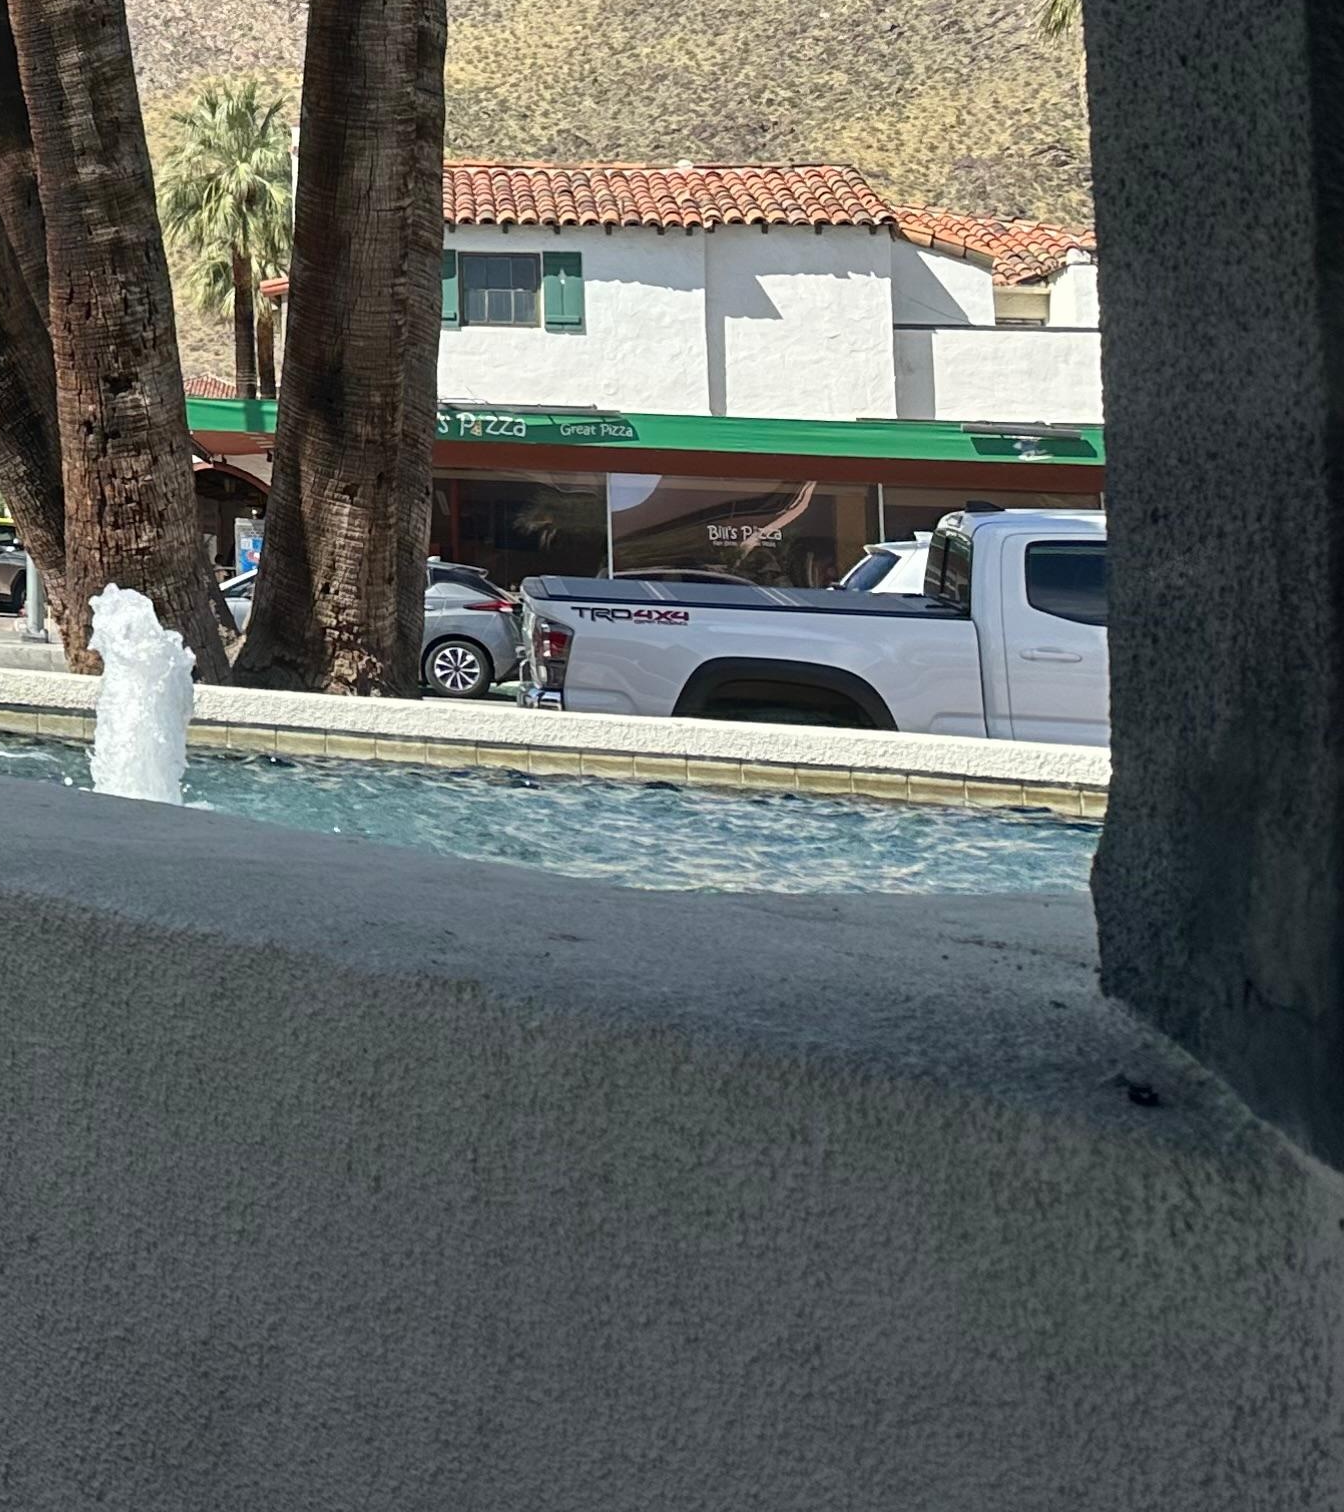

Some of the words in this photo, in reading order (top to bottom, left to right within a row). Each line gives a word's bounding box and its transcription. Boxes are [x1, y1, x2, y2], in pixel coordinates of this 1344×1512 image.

[456, 412, 526, 438] Pizza
[559, 422, 596, 436] Great
[599, 424, 634, 438] Pizza
[706, 525, 738, 541] Bill's
[740, 525, 783, 541] Pizza
[570, 606, 632, 623] TRD
